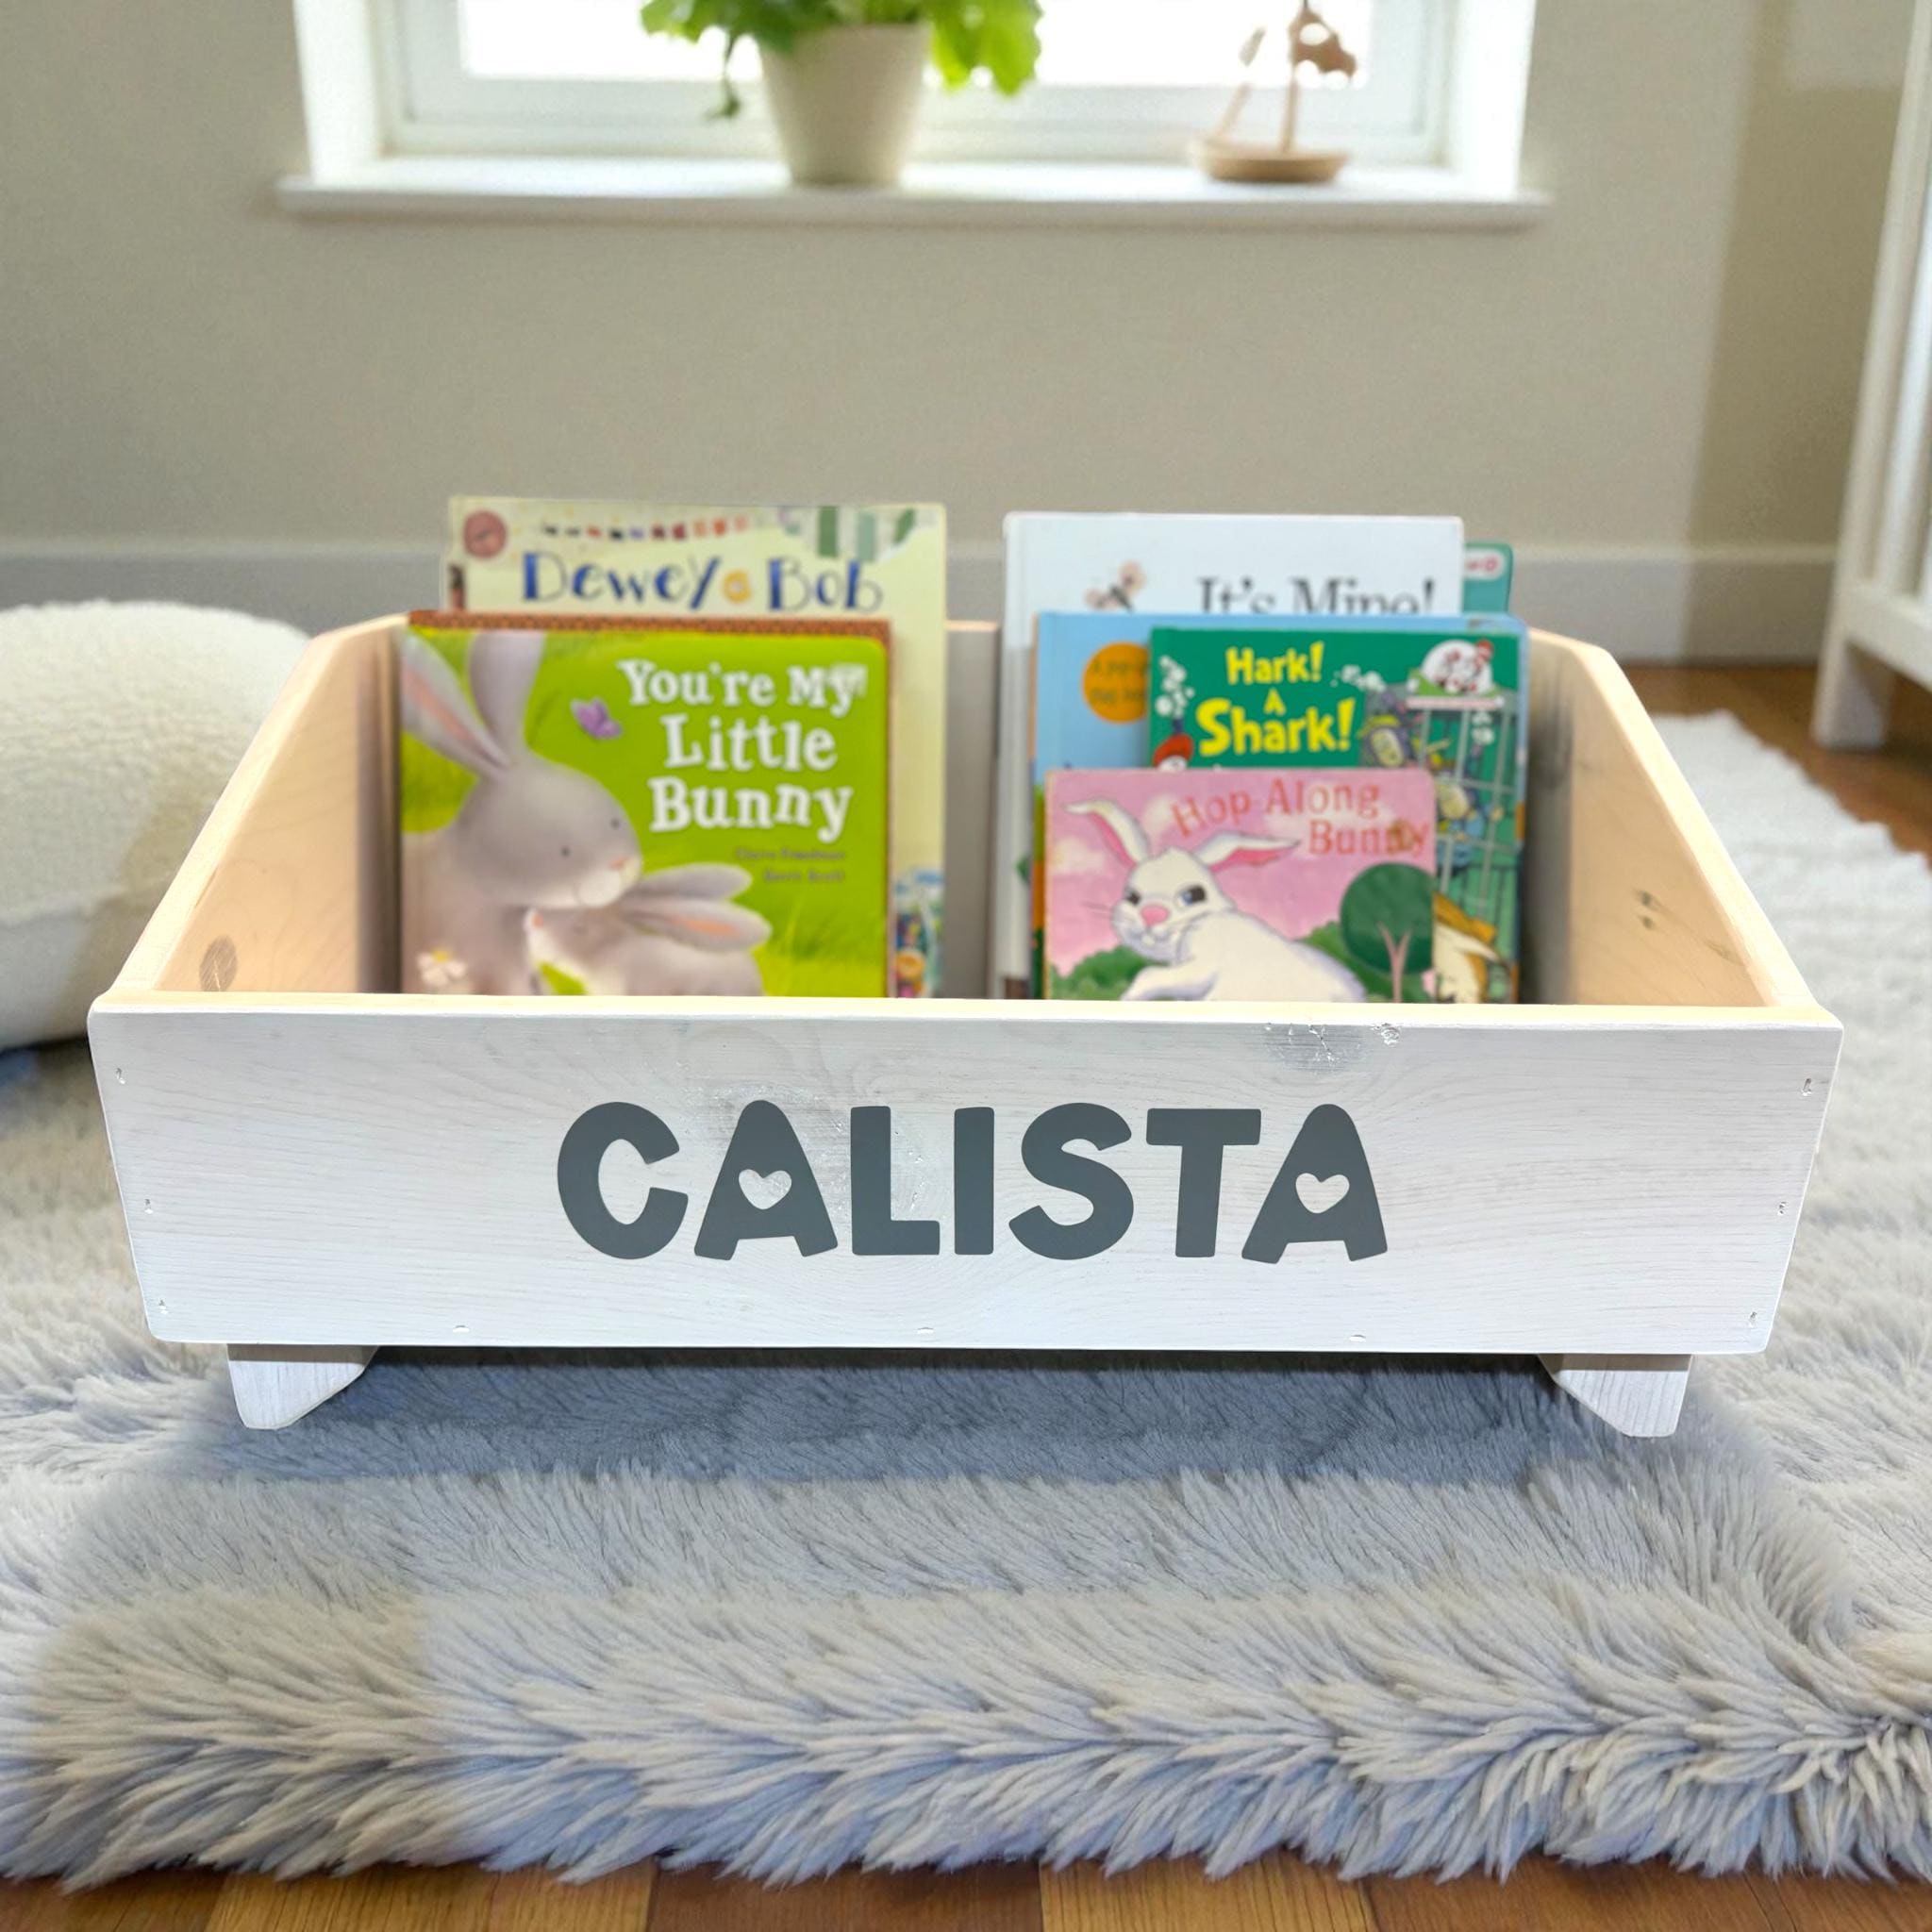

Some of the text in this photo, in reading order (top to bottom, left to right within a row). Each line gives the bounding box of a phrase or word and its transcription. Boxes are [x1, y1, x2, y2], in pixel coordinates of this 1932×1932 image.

[523, 551, 884, 612] Dewey Bob
[615, 658, 867, 718] You're My
[1225, 640, 1324, 685] Hark!
[1195, 696, 1357, 758] Shark!
[1263, 688, 1287, 716] A
[659, 712, 839, 772] Little
[646, 775, 854, 844] Bunny
[1173, 777, 1381, 838] Hop Along
[557, 1099, 1388, 1264] CALISTA
